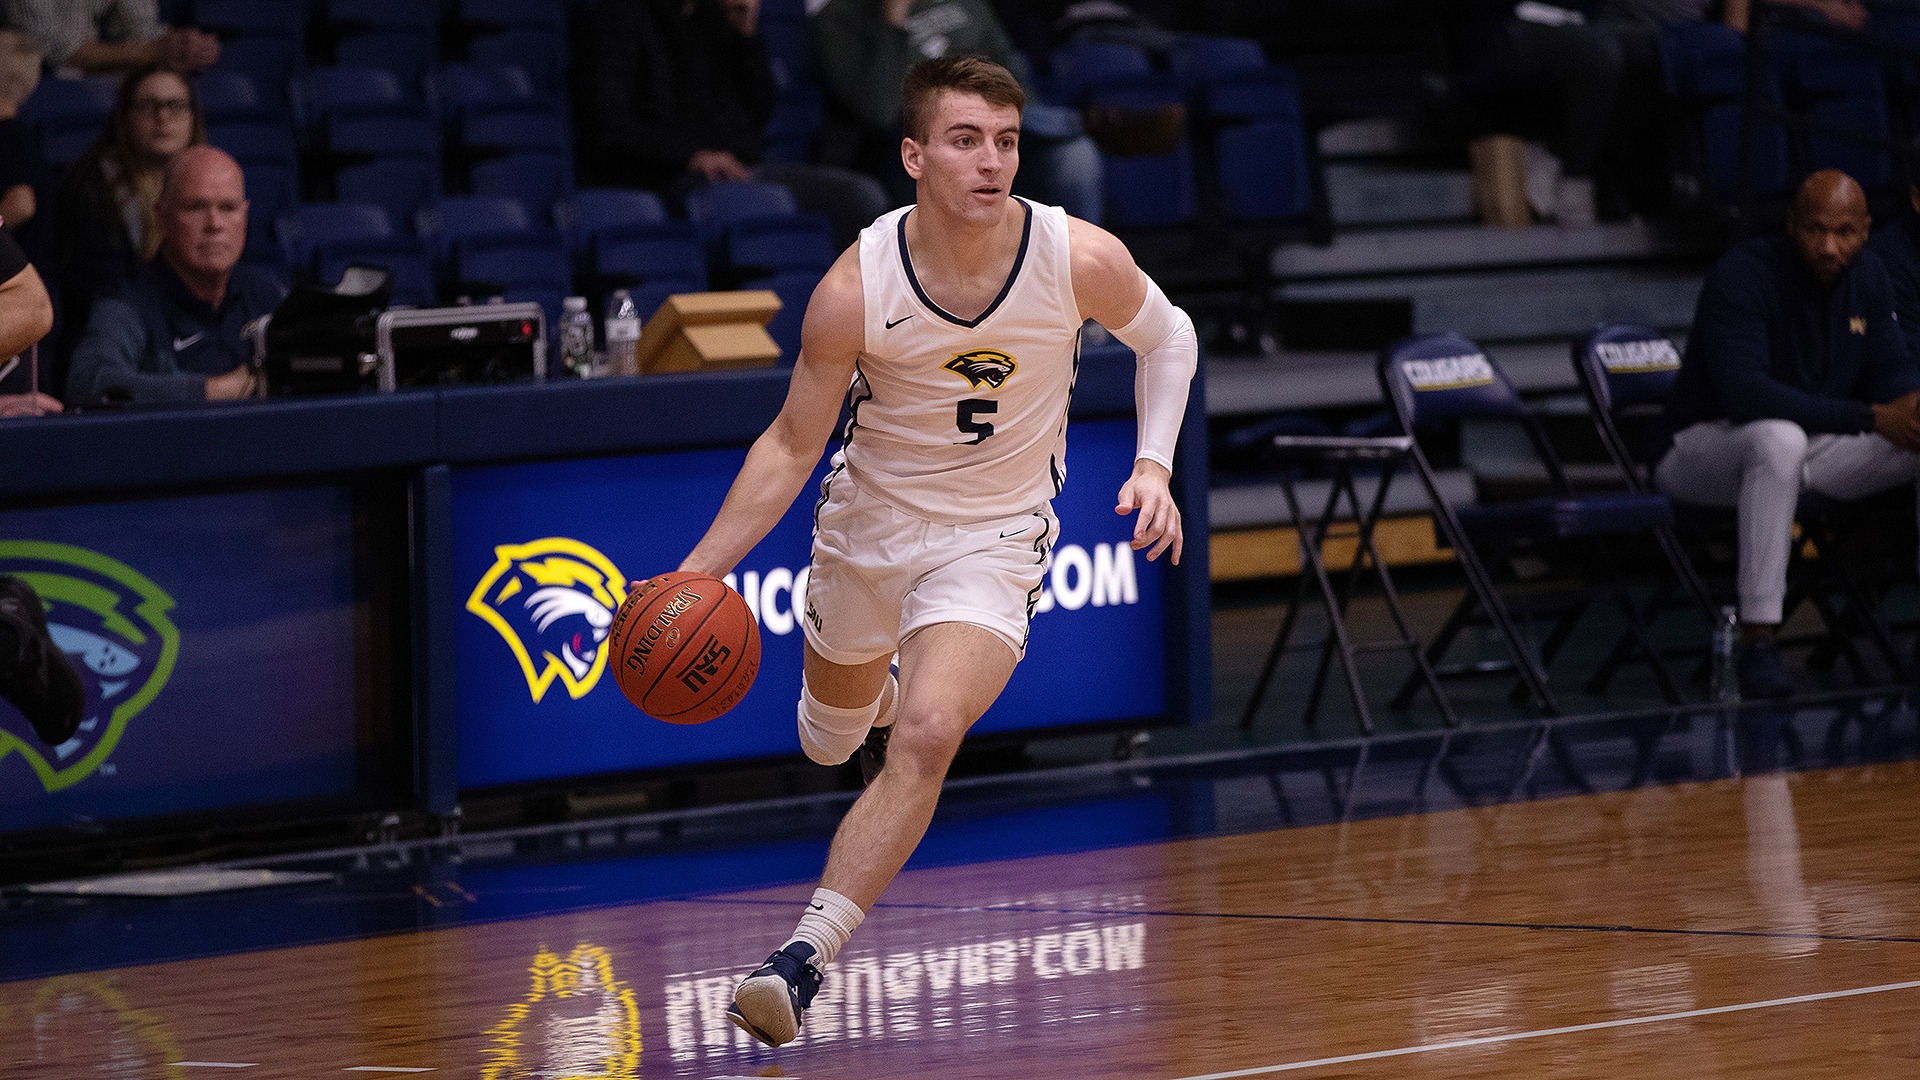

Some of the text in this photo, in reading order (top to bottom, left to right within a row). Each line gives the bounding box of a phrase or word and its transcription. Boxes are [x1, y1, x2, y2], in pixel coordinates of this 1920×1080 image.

[953, 398, 998, 445] 5
[626, 586, 702, 676] SPALDING
[806, 601, 823, 633] SAU
[676, 634, 731, 693] SAU
